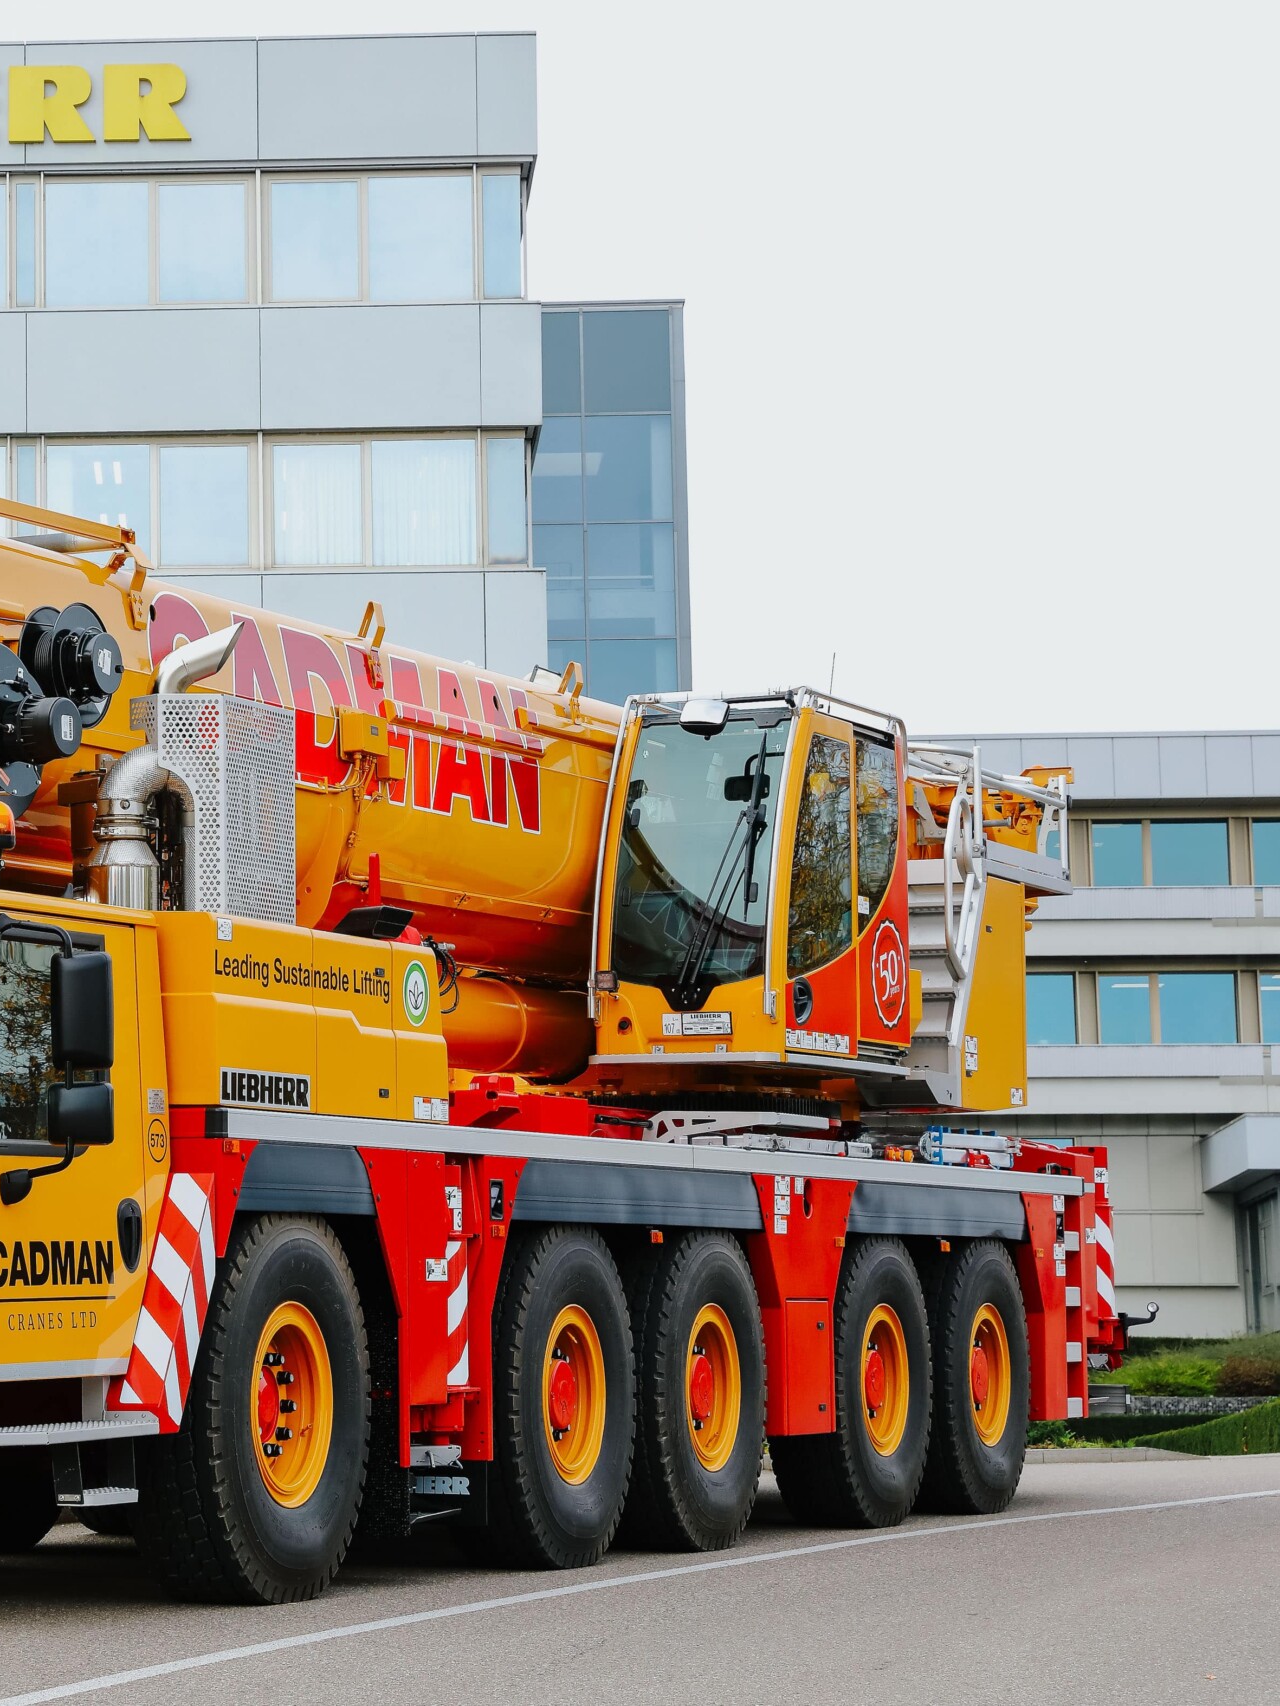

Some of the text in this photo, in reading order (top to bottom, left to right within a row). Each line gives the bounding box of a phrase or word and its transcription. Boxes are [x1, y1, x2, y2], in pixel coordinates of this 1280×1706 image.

[214, 949, 390, 1004] Leading Sustainable Lifting
[879, 949, 898, 1001] 50
[221, 1071, 309, 1107] LIEBHERR
[150, 1133, 165, 1148] 573
[8, 1311, 97, 1331] CRANES LTD
[409, 1476, 470, 1495] HERR
